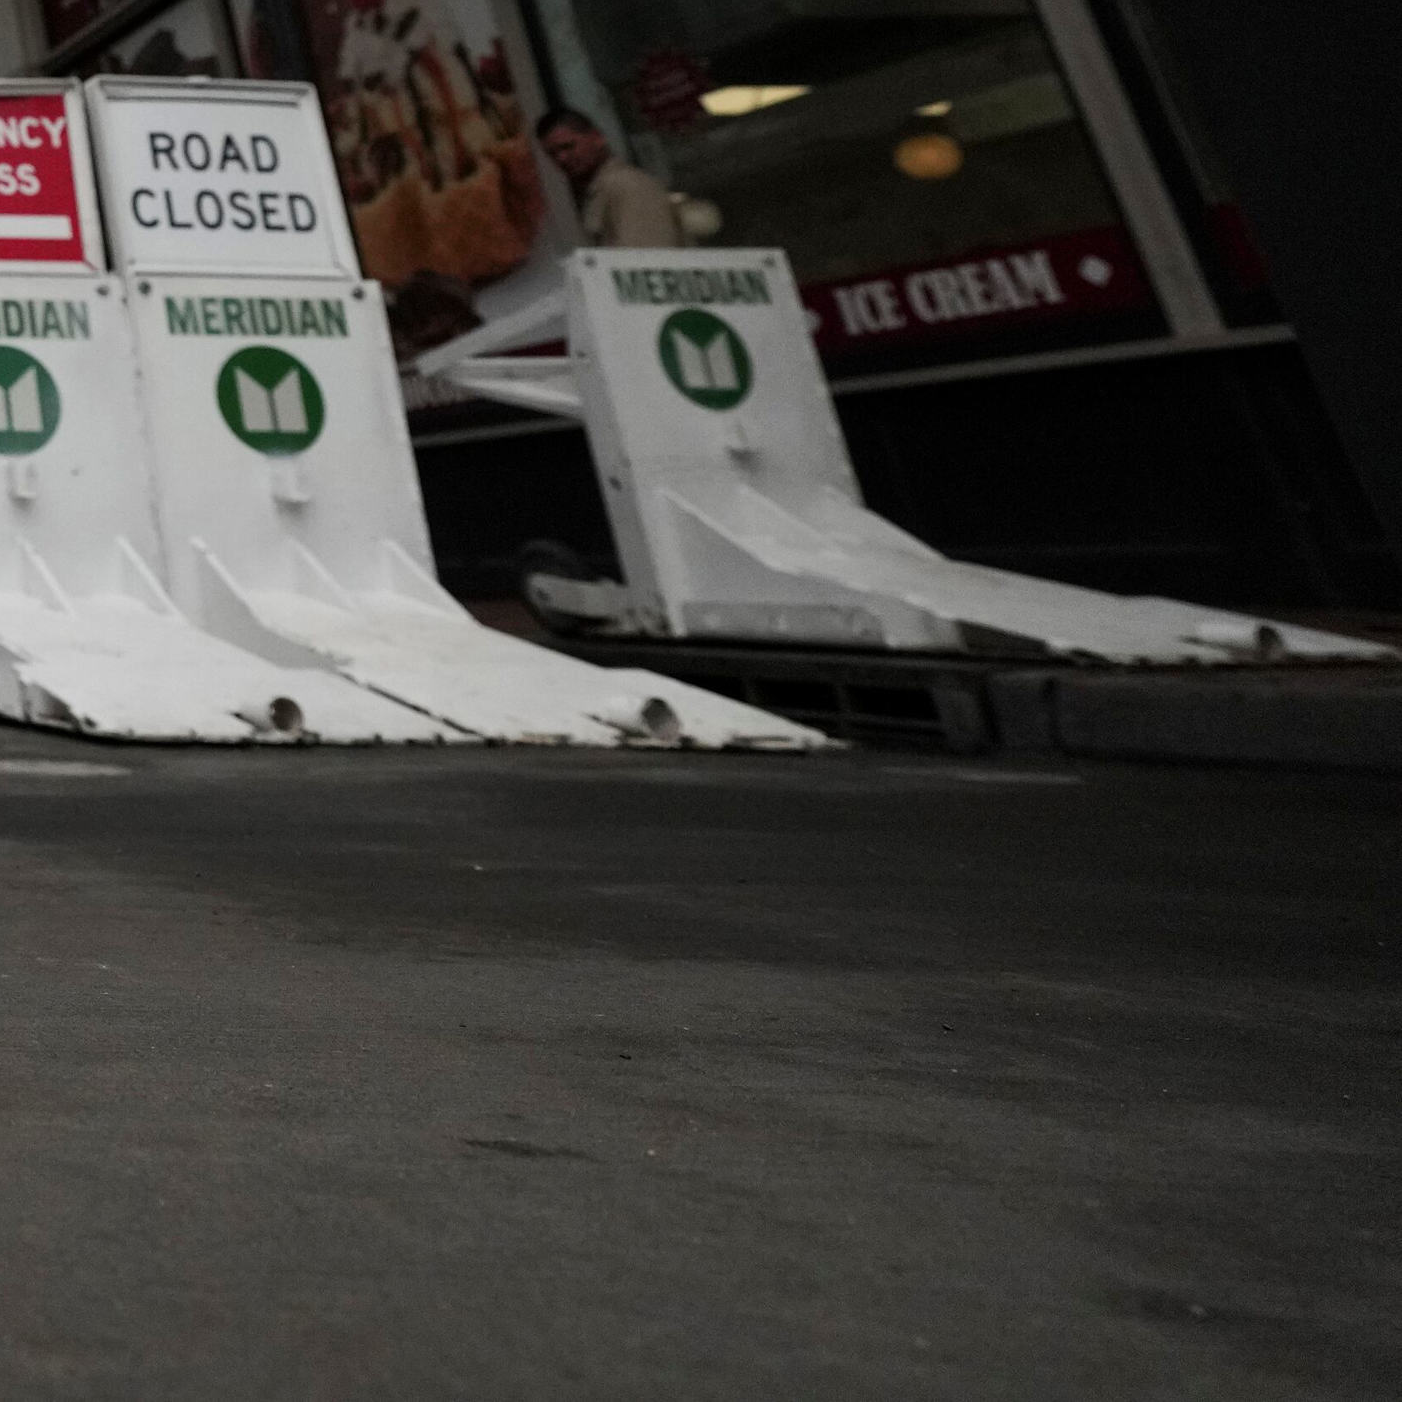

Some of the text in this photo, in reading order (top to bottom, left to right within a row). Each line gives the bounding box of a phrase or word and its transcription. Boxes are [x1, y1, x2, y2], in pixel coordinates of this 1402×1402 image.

[149, 132, 280, 174] ROAD
[132, 189, 318, 233] CLOSED
[612, 267, 773, 306] MERIDIAN
[831, 249, 1068, 337] ICE CREAM
[165, 296, 350, 339] MERIDIAN
